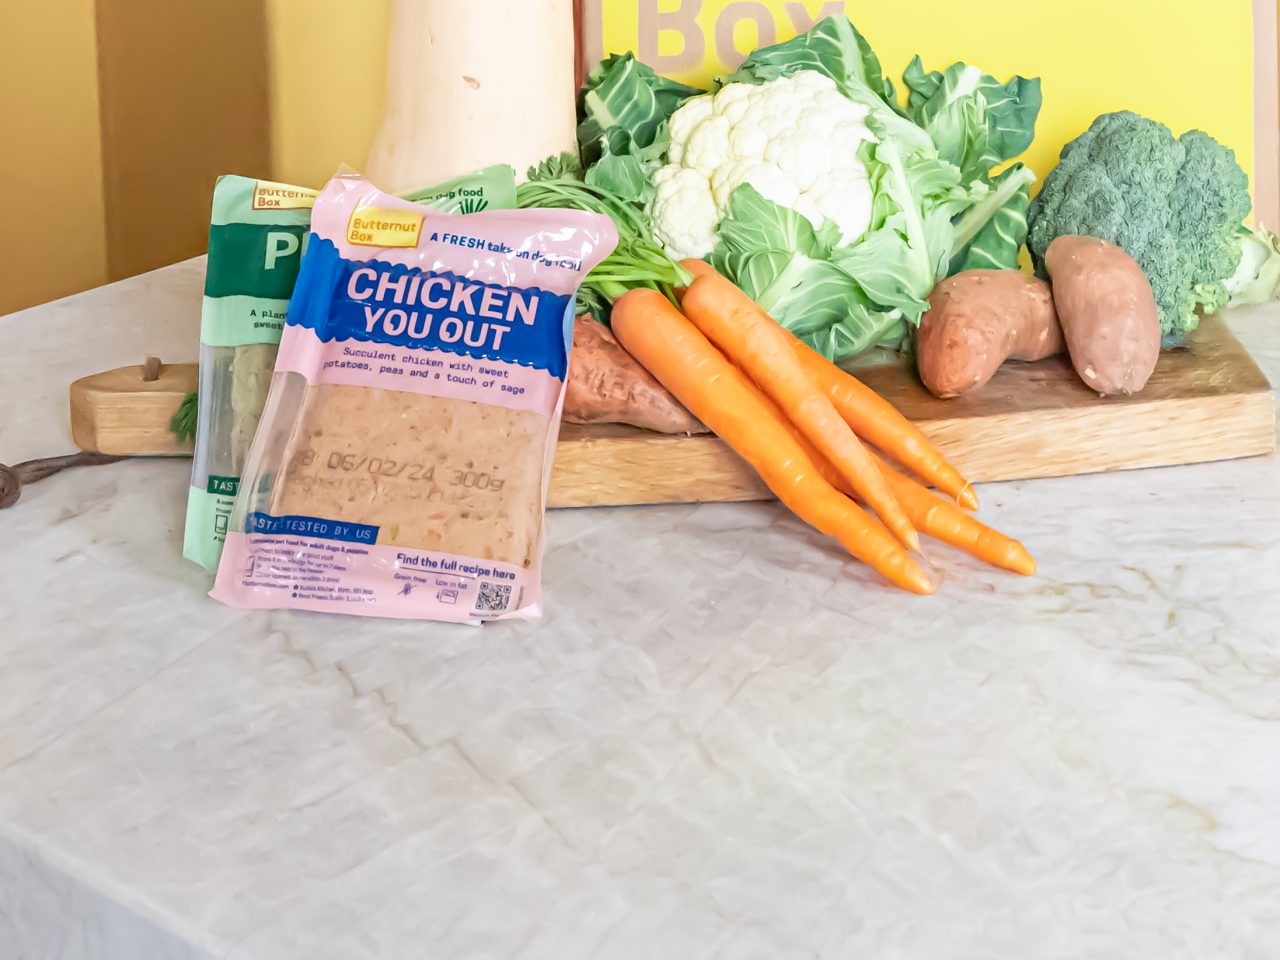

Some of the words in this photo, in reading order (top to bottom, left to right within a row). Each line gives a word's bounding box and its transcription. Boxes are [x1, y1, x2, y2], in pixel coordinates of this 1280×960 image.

[258, 197, 280, 206] Box
[458, 187, 483, 197] food
[350, 230, 373, 241] Box
[353, 218, 416, 232] Butternut
[430, 233, 438, 241] A
[442, 233, 485, 250] FRESH
[347, 268, 539, 326] CHICKEN
[363, 306, 433, 339] YOU
[438, 317, 511, 350] OUT
[343, 346, 396, 361] Succulent
[402, 352, 444, 367] chicken
[449, 361, 473, 372] with
[478, 368, 509, 378] sweet
[323, 360, 373, 372] potatoes,
[380, 364, 404, 375] peas
[410, 369, 428, 378] and
[446, 374, 477, 386] touch
[482, 380, 494, 388] of
[500, 386, 525, 395] sage
[327, 451, 436, 482] 06/02/24
[450, 468, 505, 491] 300g
[334, 524, 349, 536] BY
[356, 529, 372, 539] US
[397, 553, 418, 565] Find
[421, 558, 437, 568] the
[440, 559, 457, 570] full
[459, 564, 490, 578] recipe
[493, 568, 516, 580] here
